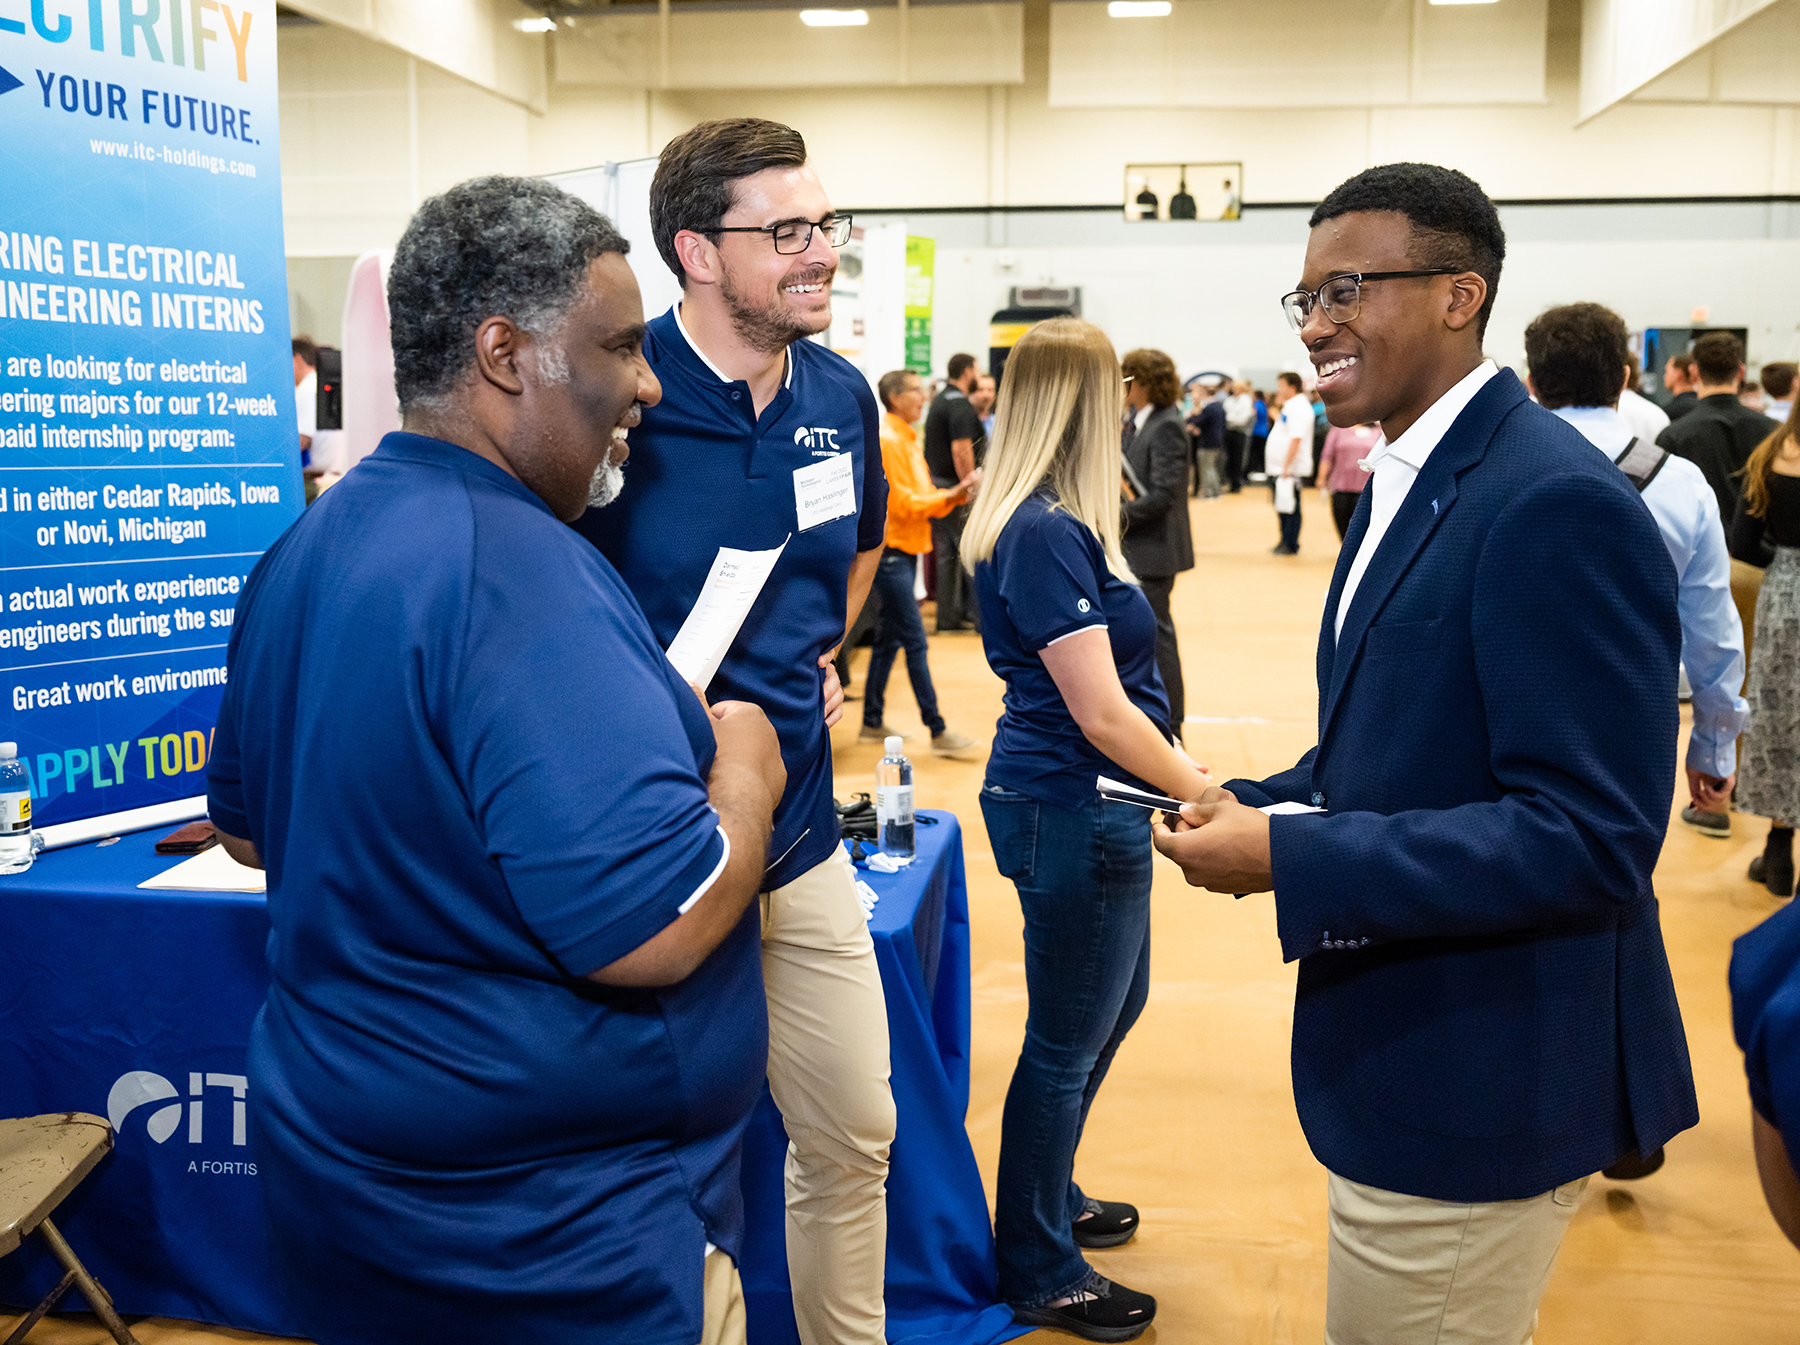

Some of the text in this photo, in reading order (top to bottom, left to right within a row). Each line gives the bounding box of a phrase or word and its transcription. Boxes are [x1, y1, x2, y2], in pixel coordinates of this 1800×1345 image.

[35, 68, 260, 145] YOUR FUTURE.
[90, 138, 257, 178] www.itc-holdings.com
[72, 239, 245, 289] ELECTRICAL
[152, 292, 265, 335] INTERNS
[7, 356, 42, 378] are
[46, 353, 121, 386] looking
[125, 357, 155, 381] for
[160, 358, 248, 384] electrical
[0, 387, 277, 419] ering majors for our 12-week
[42, 423, 143, 453] internship
[148, 428, 235, 453] program:
[13, 487, 32, 512] in
[38, 486, 98, 511] either
[103, 484, 163, 509] Cedar
[167, 482, 236, 510] Rapids,
[240, 481, 280, 504] Iowa
[804, 498, 822, 508] Bryan
[36, 516, 207, 547] or Novi, Michigan
[9, 583, 74, 612] actual
[78, 579, 130, 606] work
[134, 574, 240, 604] experience
[0, 620, 102, 650] engineers
[107, 611, 171, 638] during
[174, 607, 206, 632] the
[12, 682, 72, 711] Great
[75, 675, 127, 702] work
[187, 1160, 258, 1176] A FORTIS
